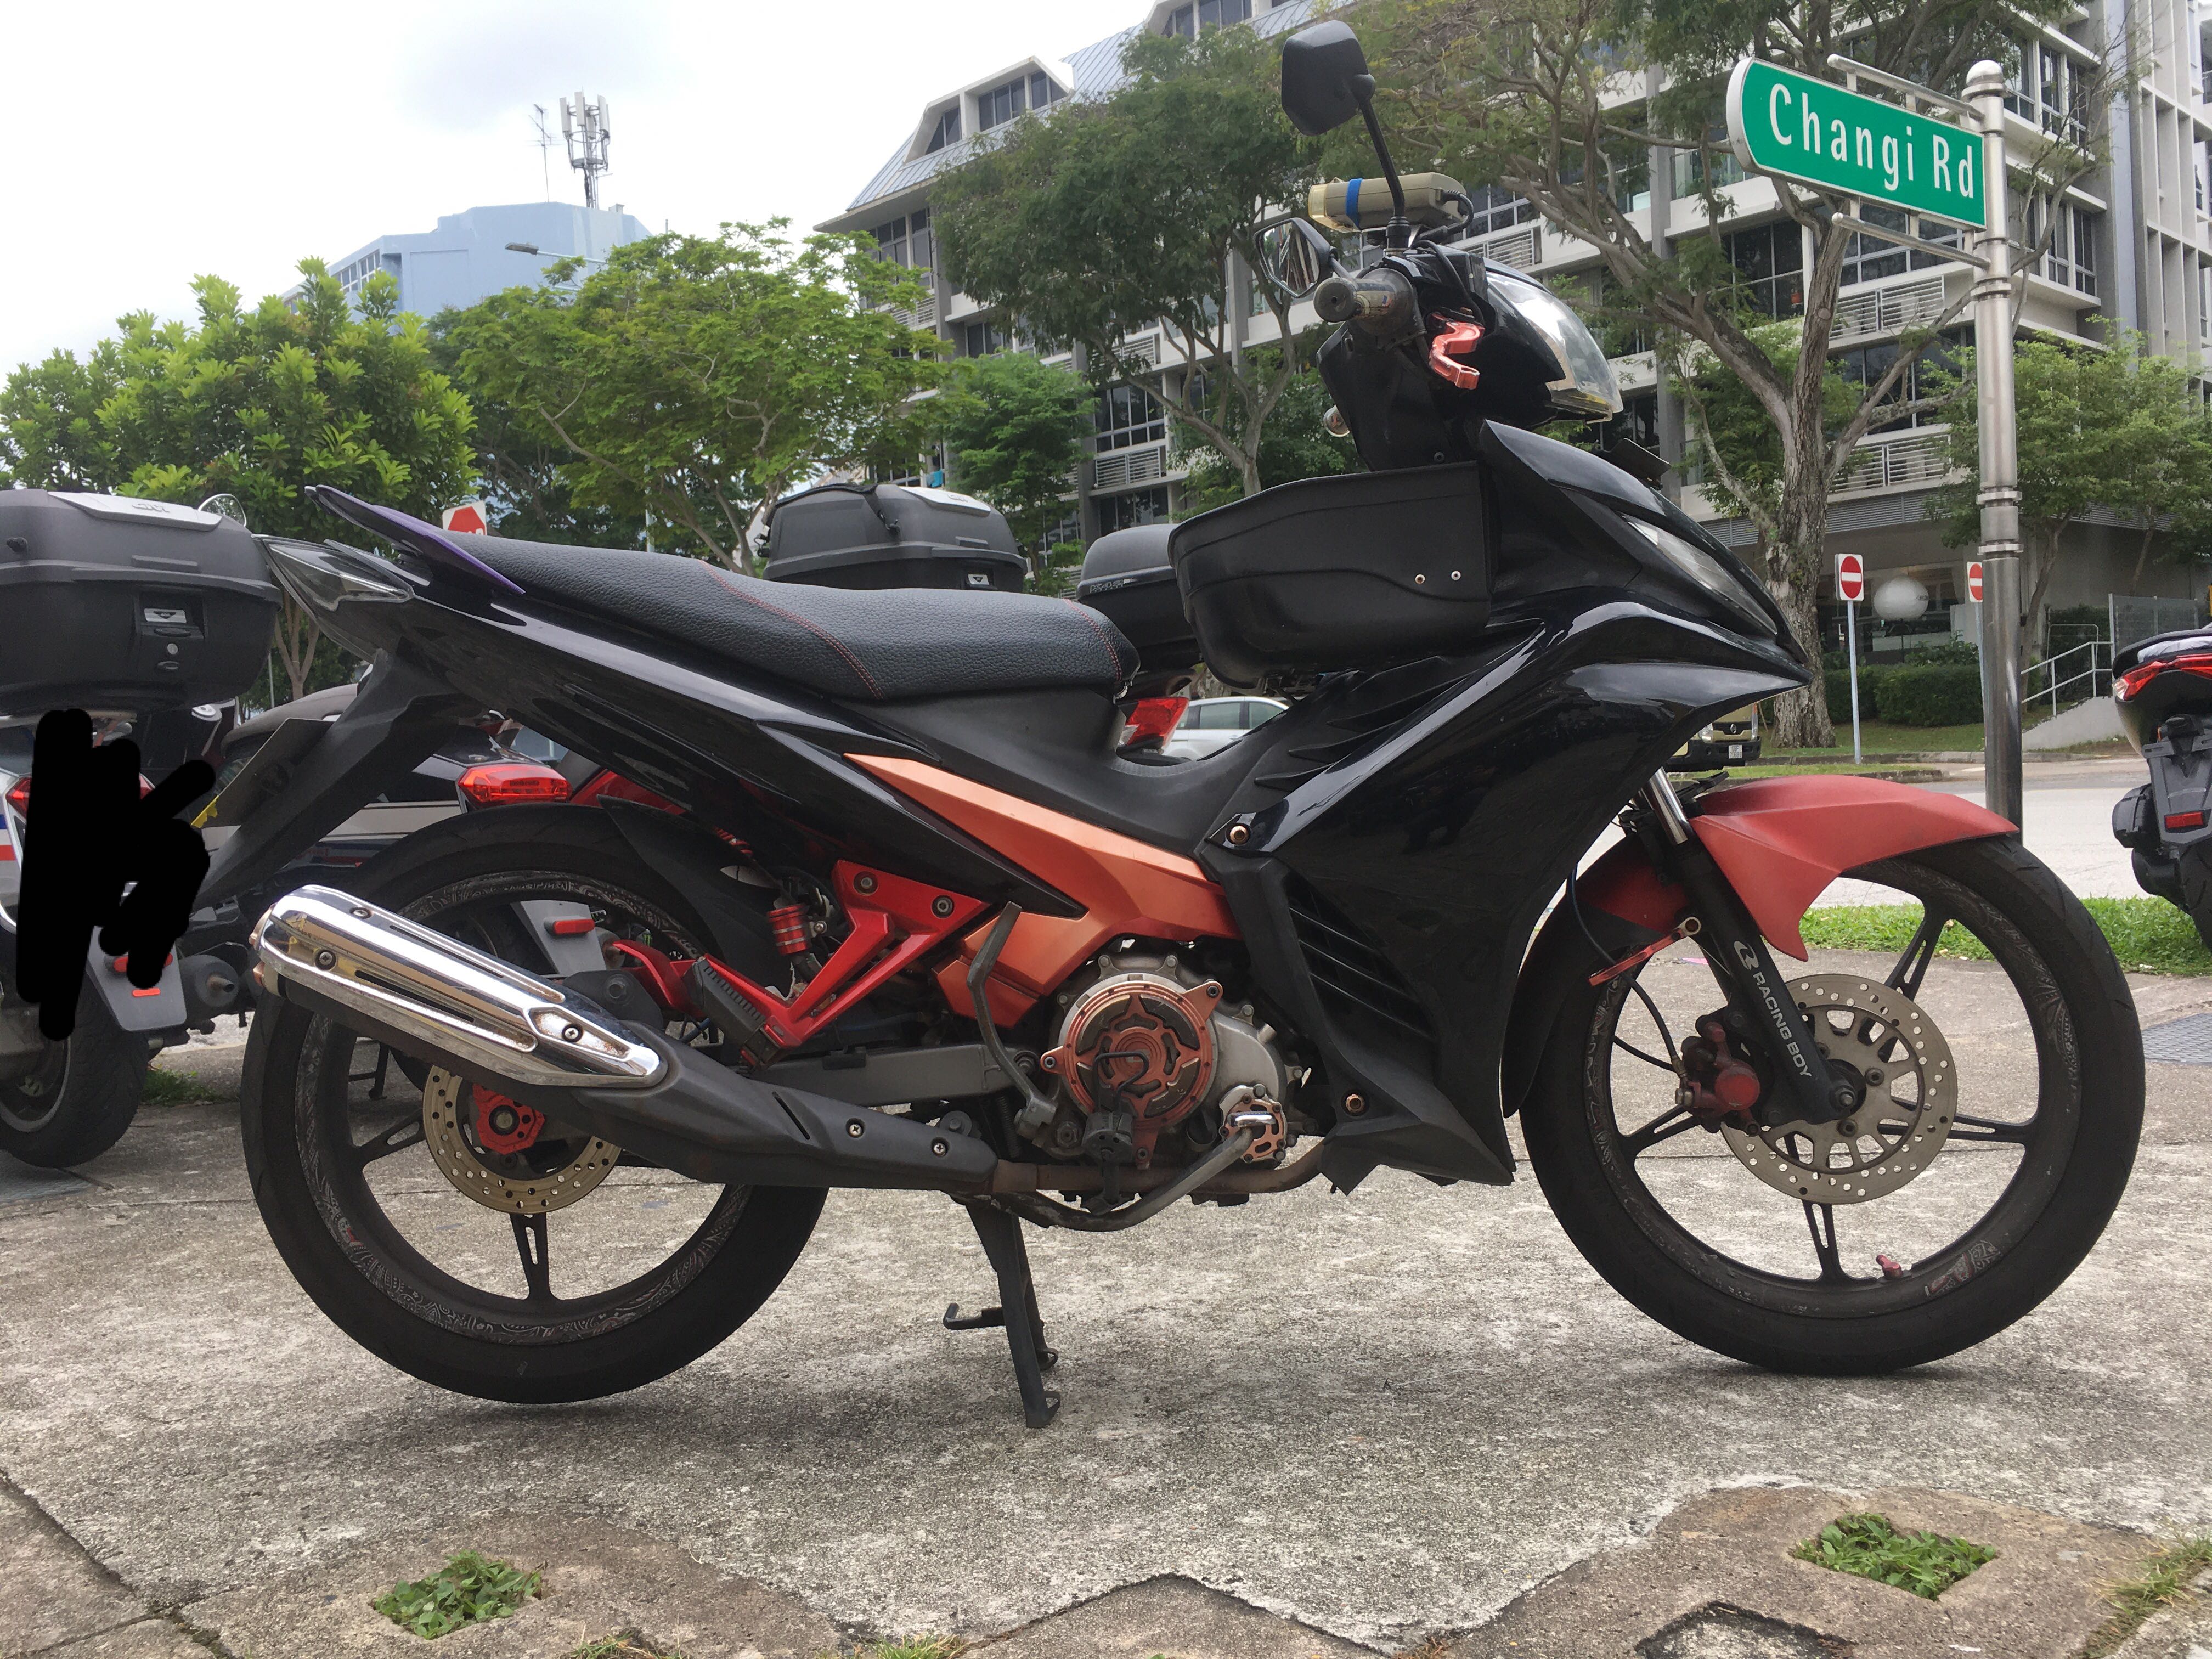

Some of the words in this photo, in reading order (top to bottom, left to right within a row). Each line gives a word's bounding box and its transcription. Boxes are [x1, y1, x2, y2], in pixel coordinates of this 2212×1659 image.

[1769, 83, 1914, 191] Changi
[1932, 134, 1974, 199] Rd
[1752, 971, 1792, 1040] RACING
[1786, 1041, 1812, 1077] BOY
